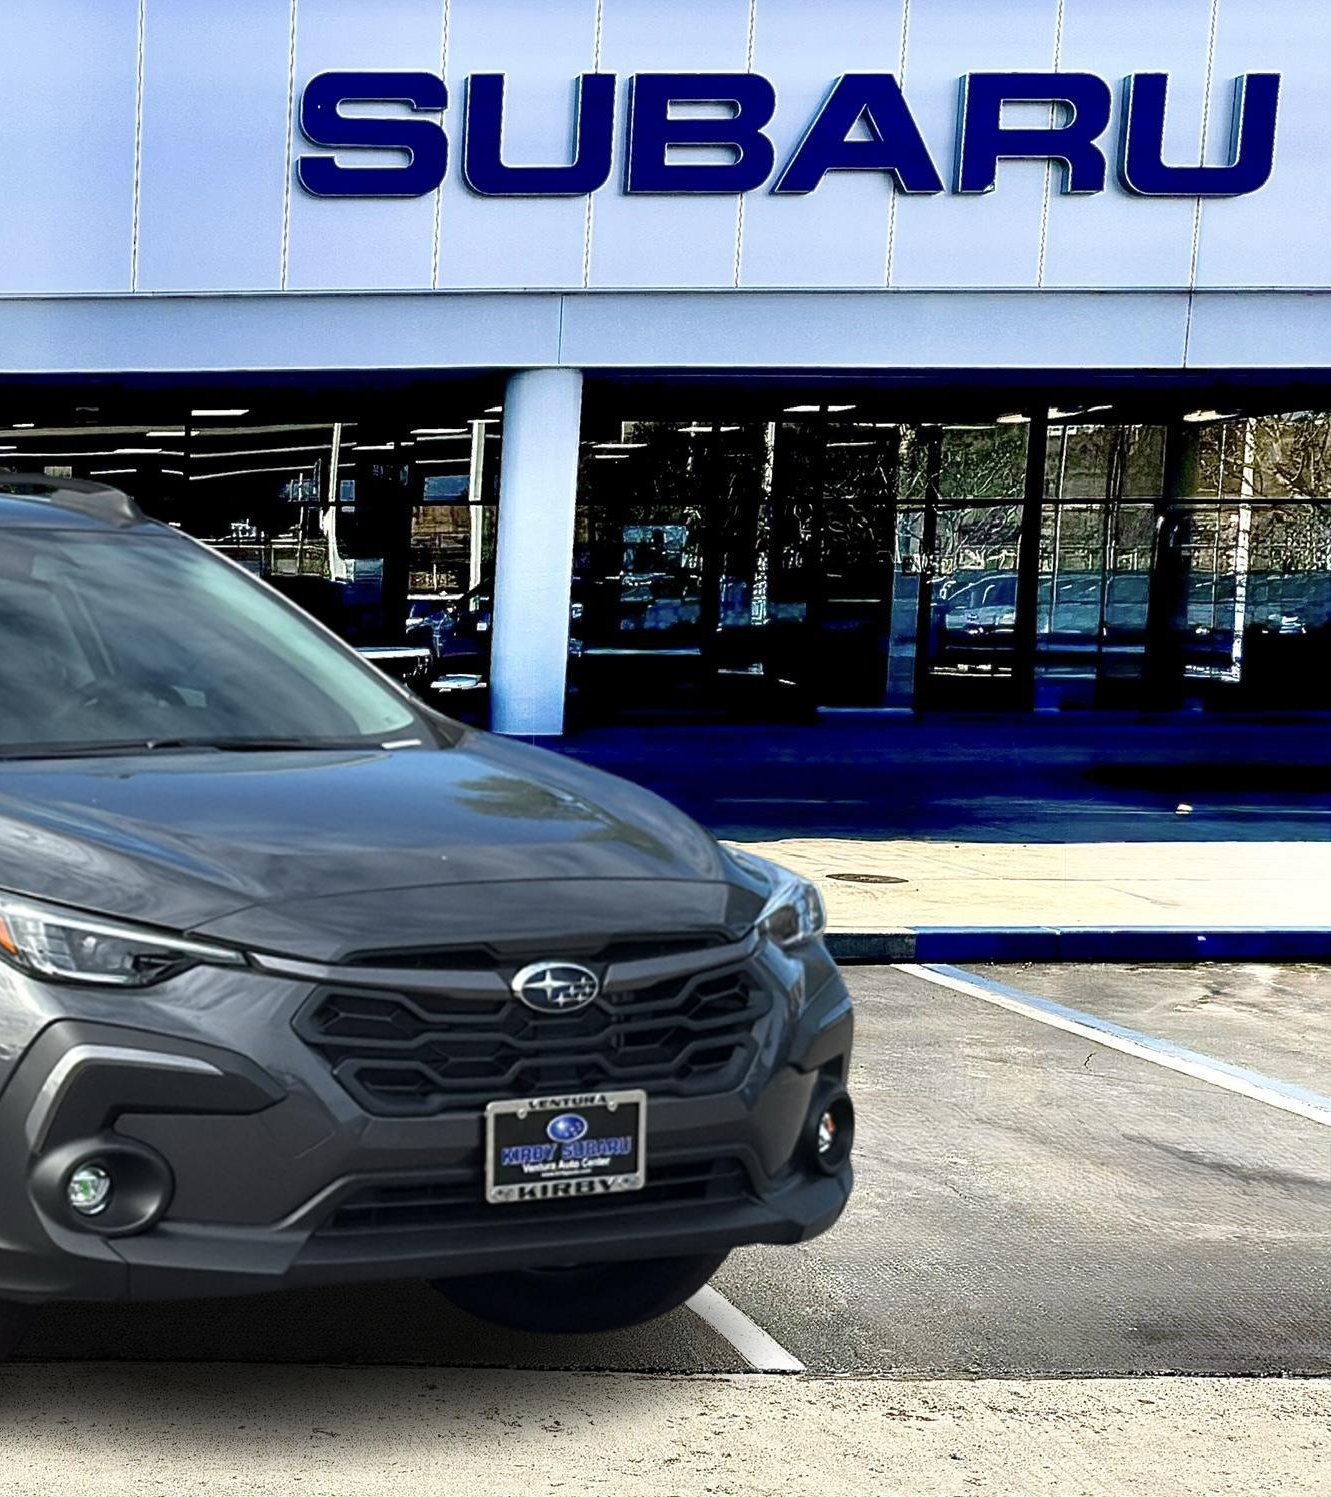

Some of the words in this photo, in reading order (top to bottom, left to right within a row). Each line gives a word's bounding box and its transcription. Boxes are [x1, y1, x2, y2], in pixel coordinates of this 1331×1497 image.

[297, 72, 1281, 197] SUBARU
[528, 1094, 607, 1110] VENTURA
[501, 1143, 558, 1166] KIRBY
[562, 1136, 631, 1159] SUBARU
[522, 1161, 556, 1174] Ventura
[558, 1158, 580, 1169] Auto
[581, 1156, 611, 1168] Center
[517, 1178, 617, 1200] KIRBY
